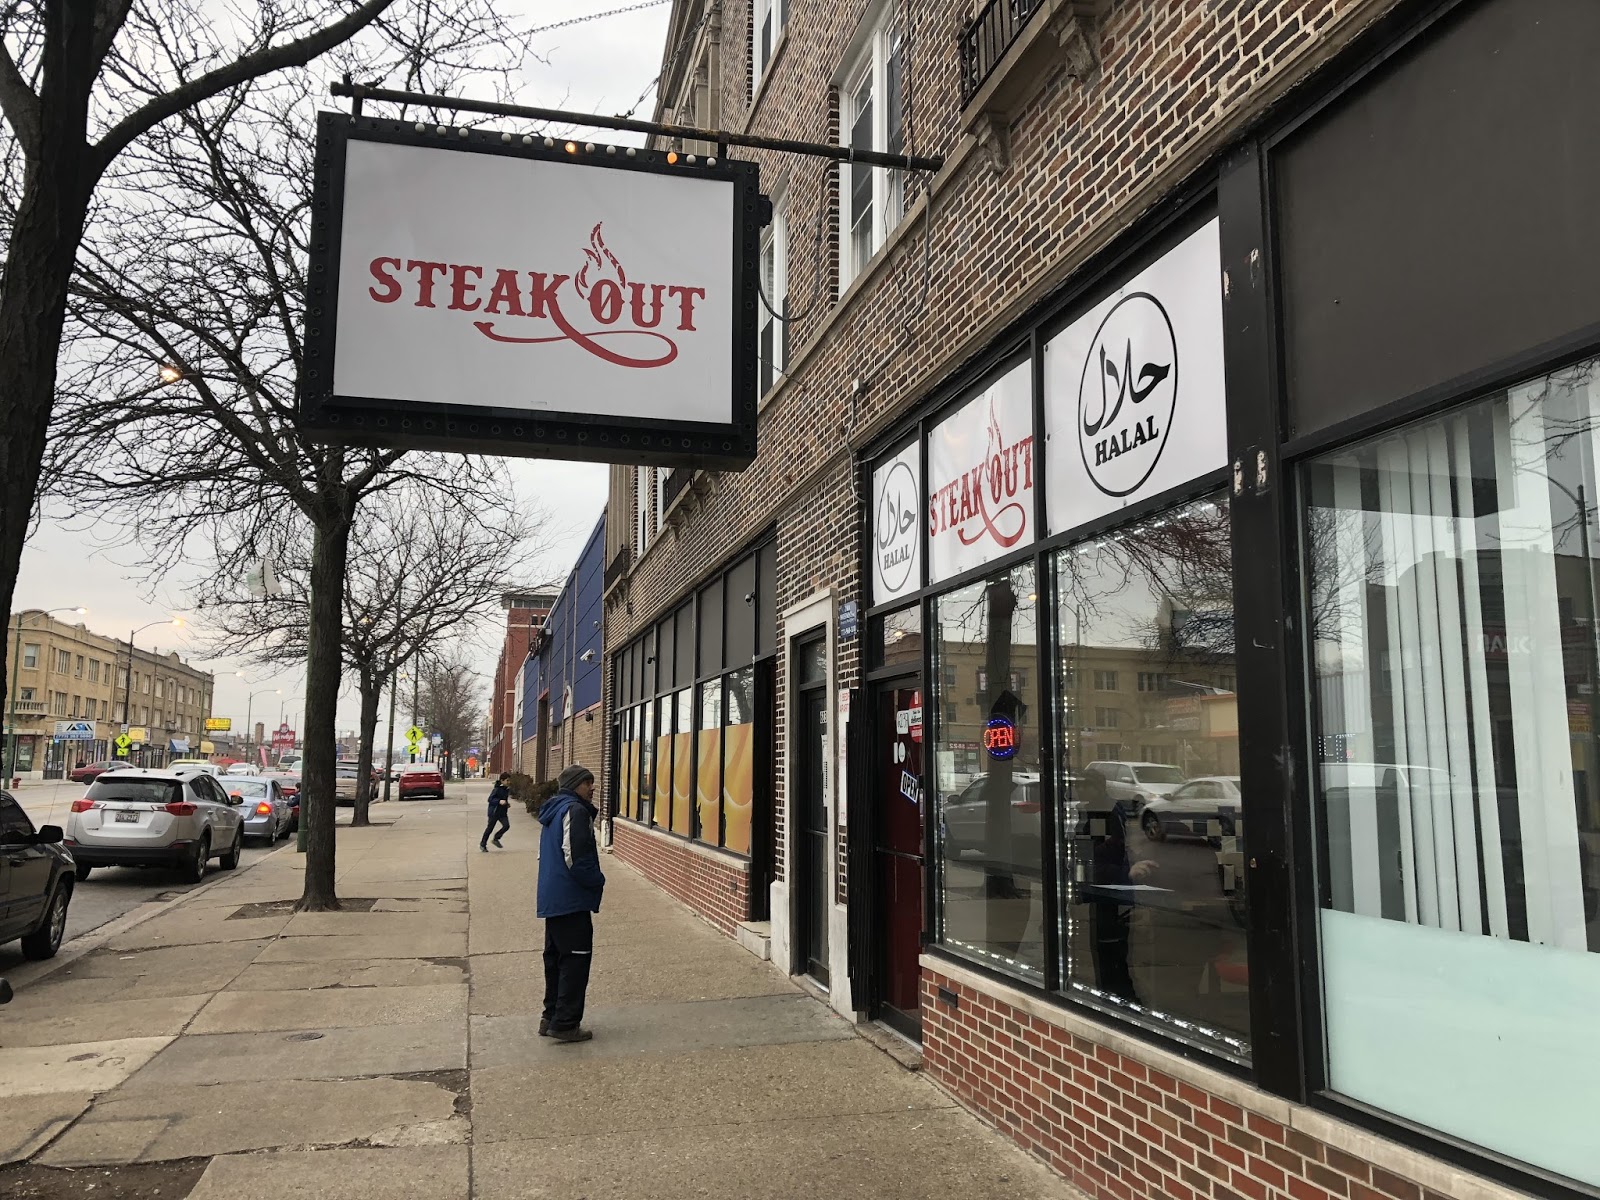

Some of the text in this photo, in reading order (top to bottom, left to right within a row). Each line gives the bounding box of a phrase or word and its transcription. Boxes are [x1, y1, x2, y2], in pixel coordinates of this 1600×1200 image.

[1083, 337, 1172, 437] حلال
[1094, 415, 1160, 467] HALAL
[879, 489, 916, 550] حلال
[884, 543, 910, 571] HALAL
[983, 727, 1013, 748] OPEN
[901, 772, 917, 801] OPEN
